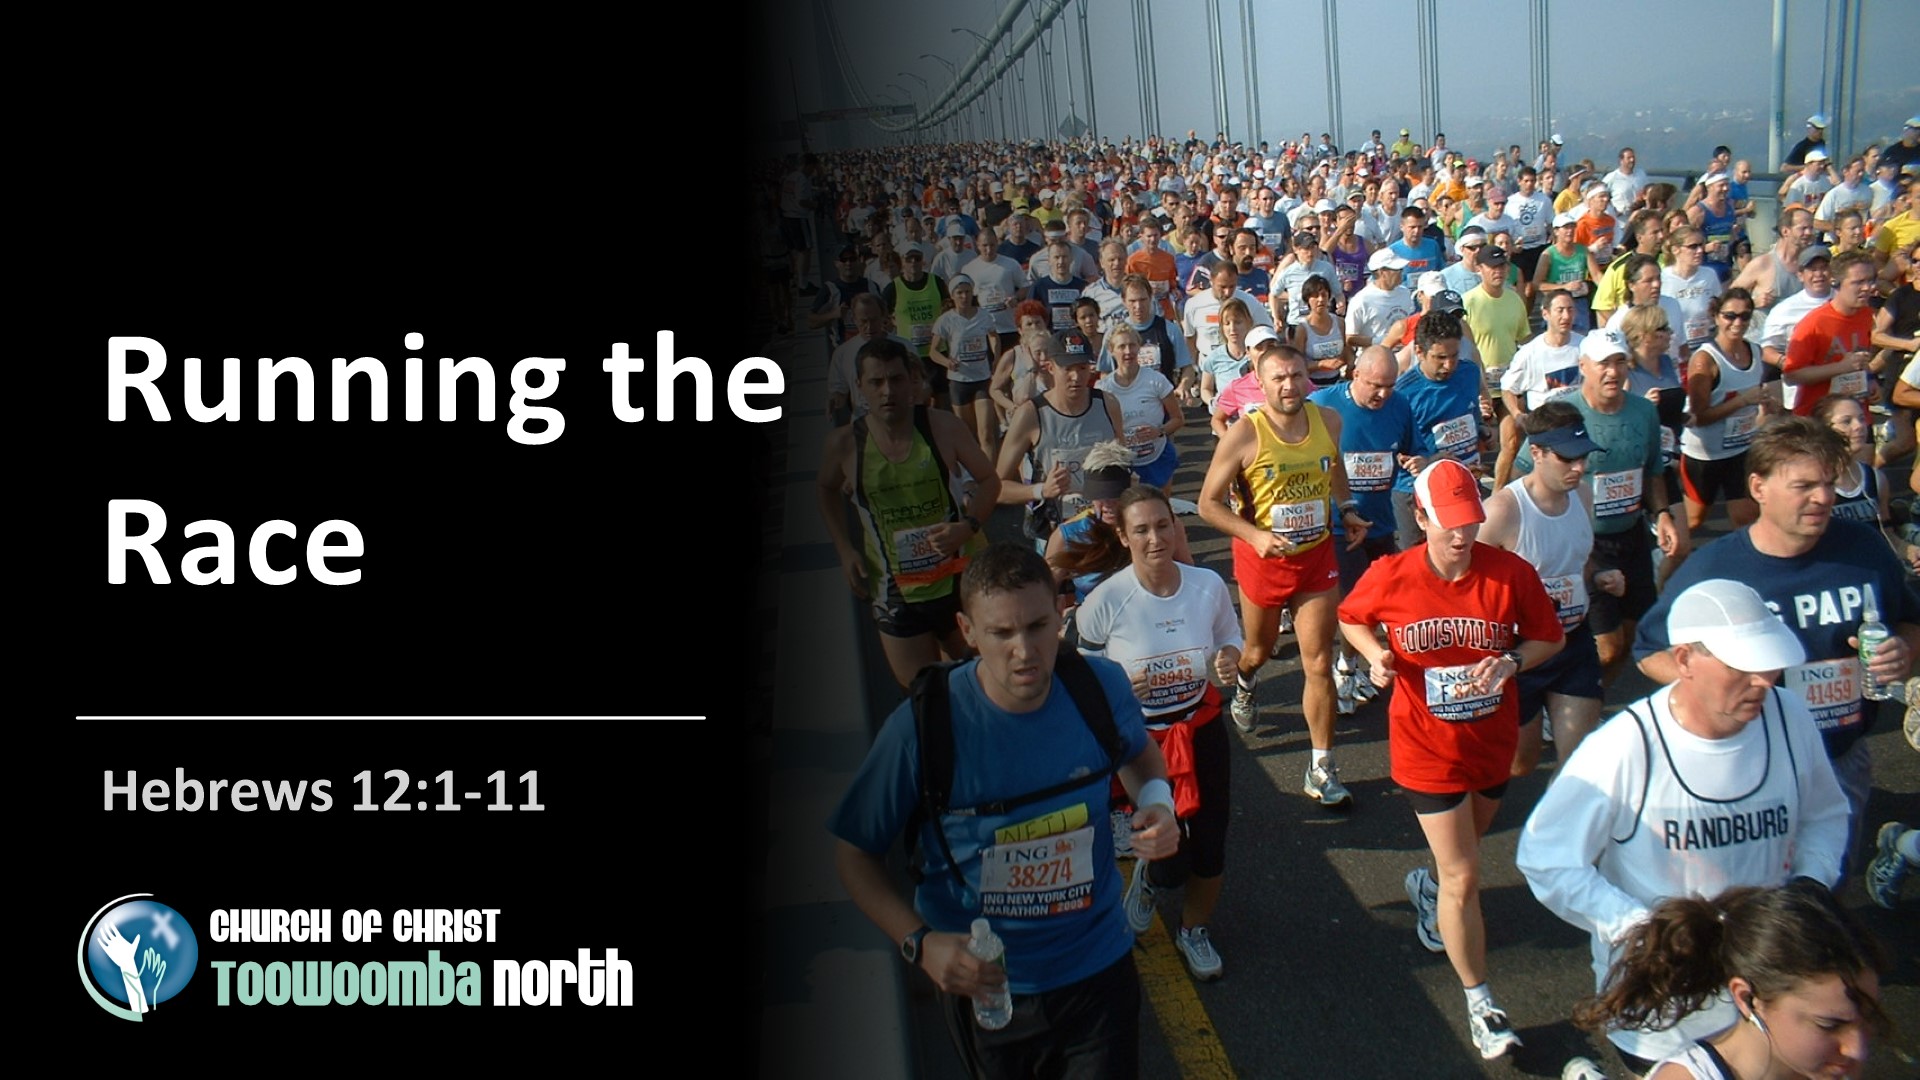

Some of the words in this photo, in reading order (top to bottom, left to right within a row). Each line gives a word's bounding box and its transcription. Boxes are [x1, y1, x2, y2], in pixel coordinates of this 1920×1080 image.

[1441, 422, 1457, 432] ING
[1287, 472, 1309, 487] GO!
[1604, 475, 1624, 485] ING
[1281, 506, 1302, 516] ING
[1284, 514, 1314, 528] 40241
[905, 530, 929, 543] ING
[911, 541, 933, 558] 364
[1545, 579, 1561, 589] NG
[1794, 582, 1878, 629] PAPA
[1147, 659, 1173, 673] ING
[1150, 668, 1193, 686] 48943
[1439, 671, 1468, 682] ING
[1801, 667, 1834, 681] ING
[1442, 684, 1449, 702] F
[1806, 679, 1851, 705] 41459
[1814, 710, 1829, 720] EW
[1664, 804, 1789, 850] RANDBURG
[1004, 846, 1048, 862] ING
[1007, 857, 1073, 888] 38274
[984, 893, 1004, 905] ING
[1007, 892, 1035, 905] NEW
[1037, 890, 1067, 904] YORK
[1068, 883, 1093, 899] CITY
[983, 904, 1048, 916] MARATHON
